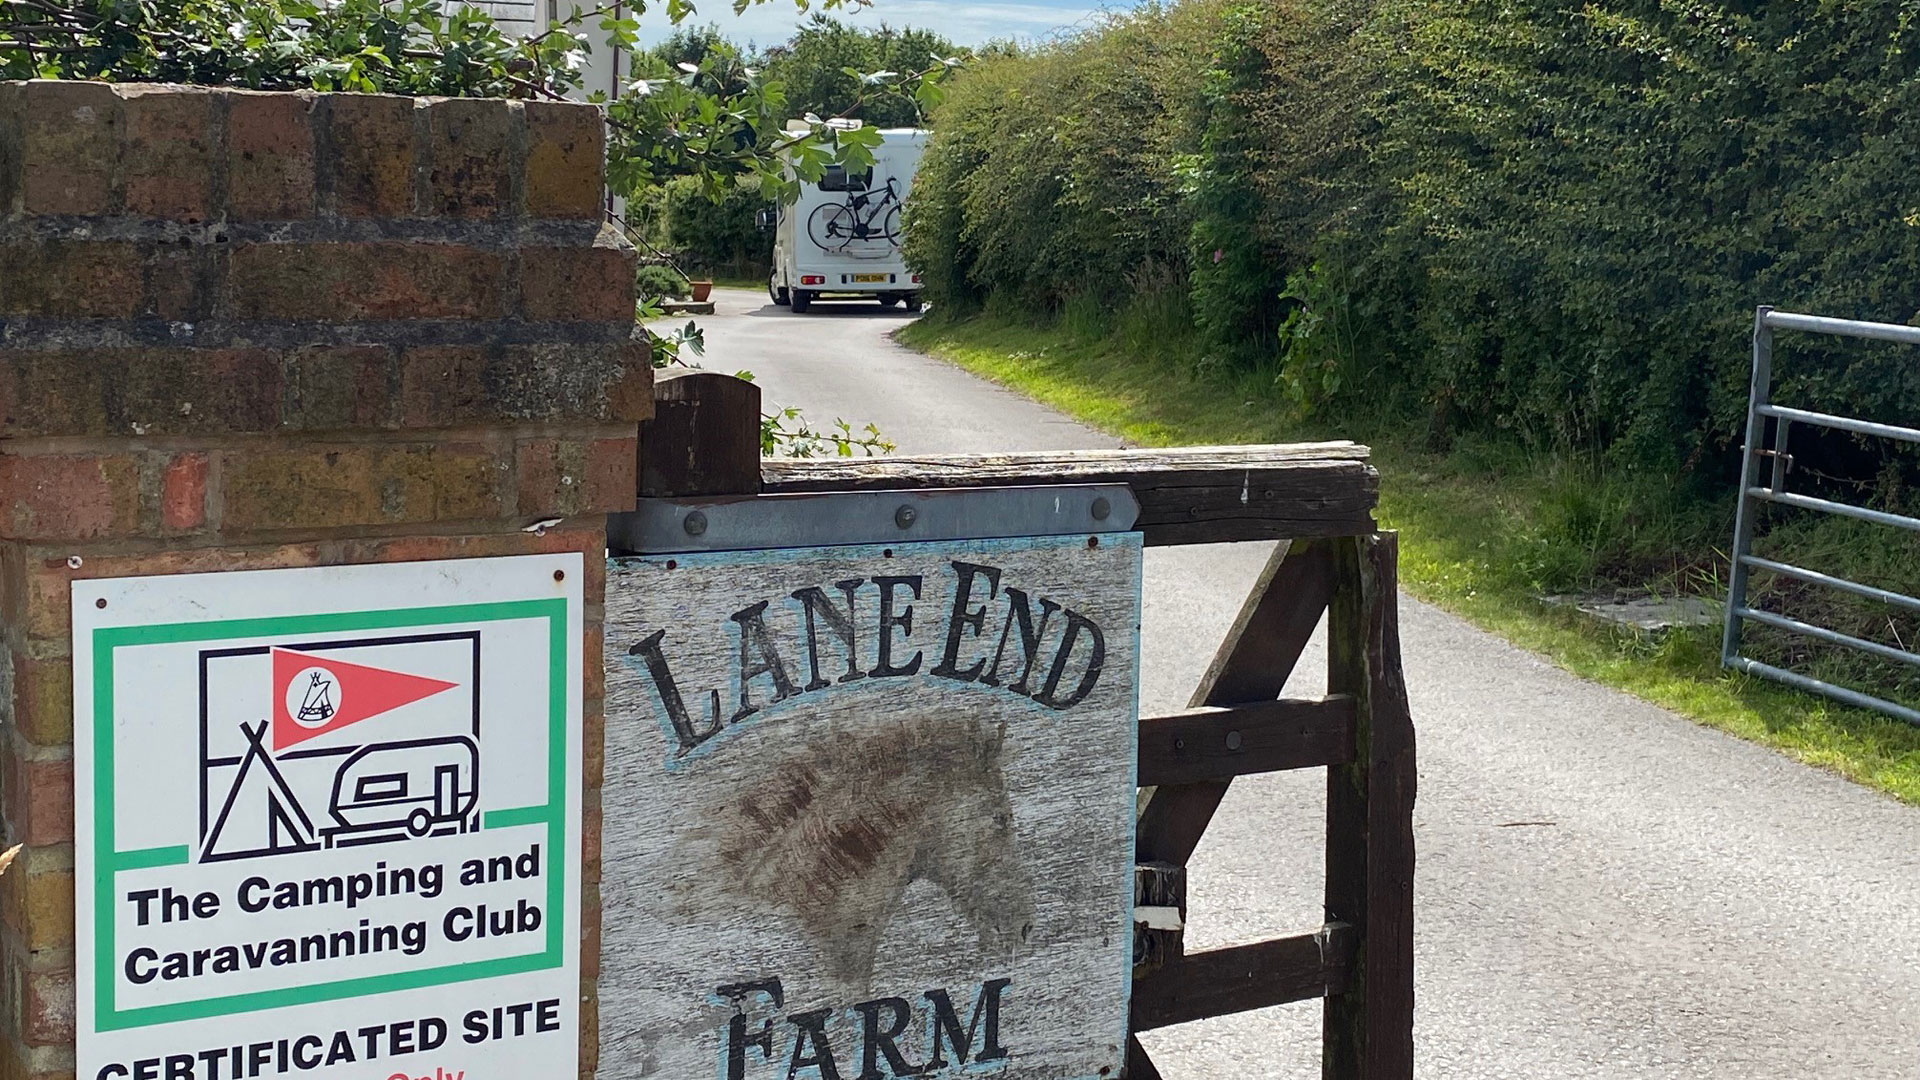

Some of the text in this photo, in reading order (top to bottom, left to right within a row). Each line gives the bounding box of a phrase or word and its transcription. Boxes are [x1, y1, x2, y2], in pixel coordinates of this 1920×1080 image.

[629, 560, 1105, 759] LANE END
[127, 844, 540, 926] The Camping and
[124, 900, 542, 984] Caravanning Club
[462, 998, 560, 1044] SITE
[716, 975, 1012, 1080] FARM
